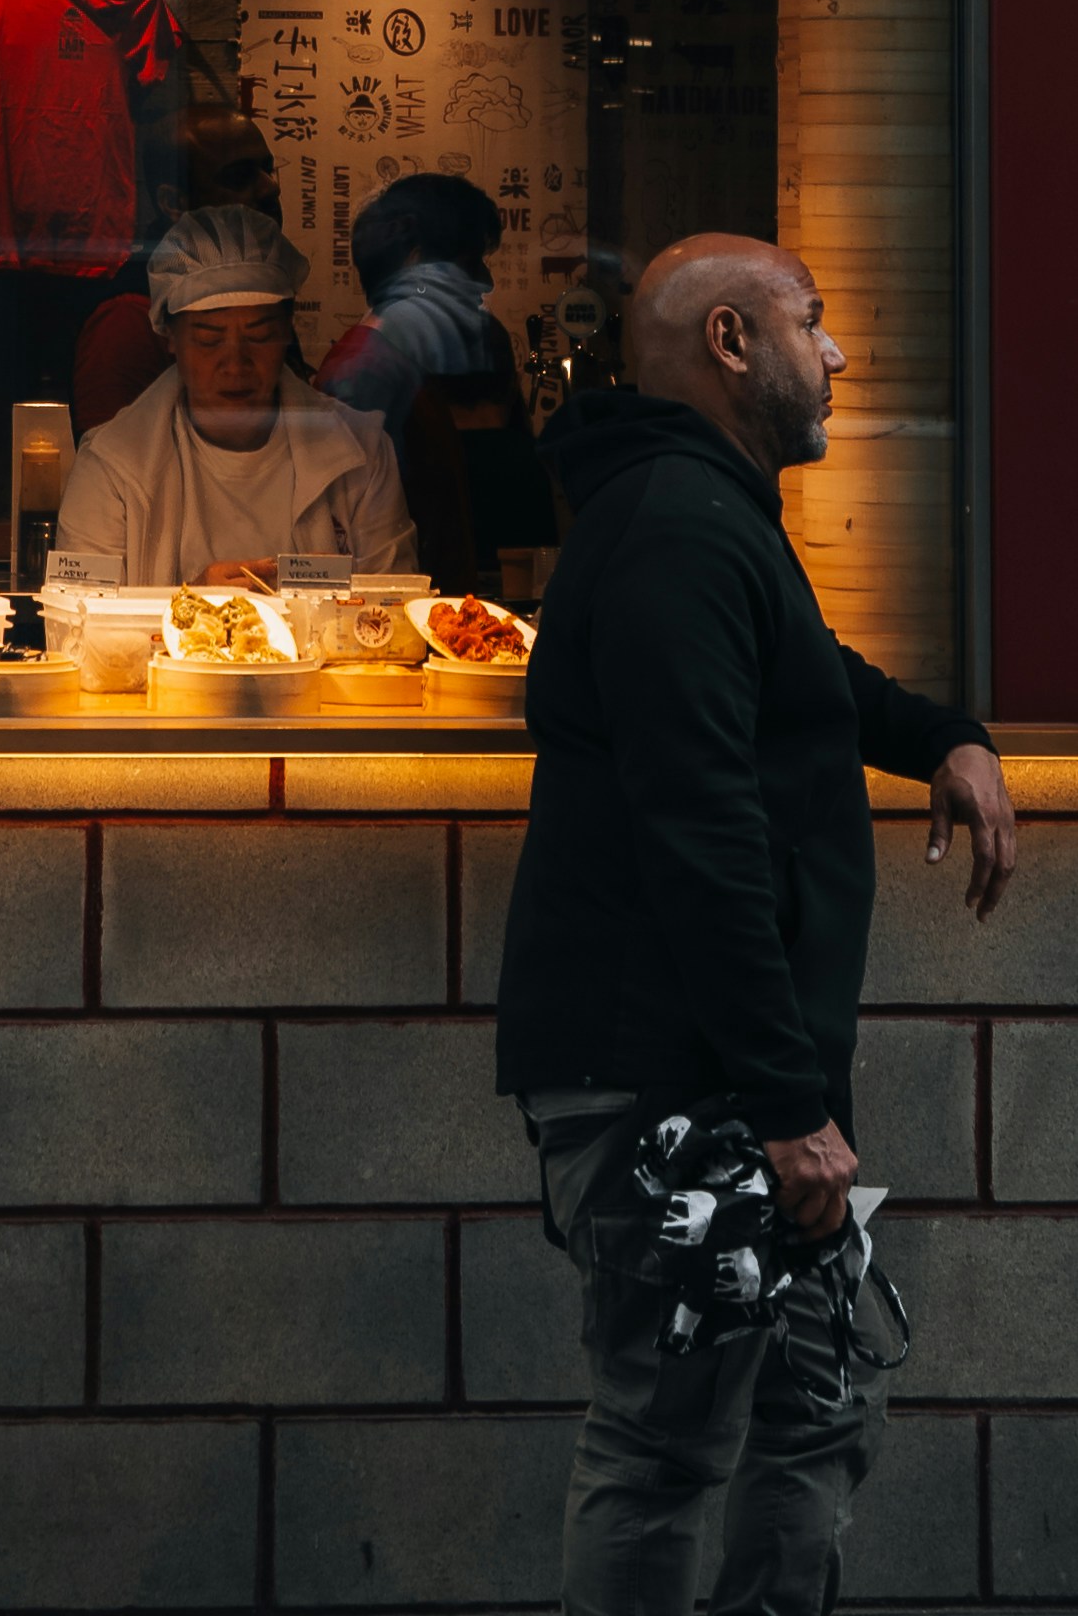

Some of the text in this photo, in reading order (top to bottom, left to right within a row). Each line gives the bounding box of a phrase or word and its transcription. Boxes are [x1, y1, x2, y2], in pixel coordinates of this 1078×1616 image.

[494, 8, 550, 37] LOVE
[561, 12, 586, 71] AMOR
[339, 76, 382, 96] LADY
[395, 74, 426, 139] WHAT
[377, 94, 393, 135] DUMPLING
[301, 156, 317, 230] DUMPLING
[333, 165, 350, 198] LADY
[333, 202, 350, 267] DUMPLING
[497, 208, 531, 232] OVE
